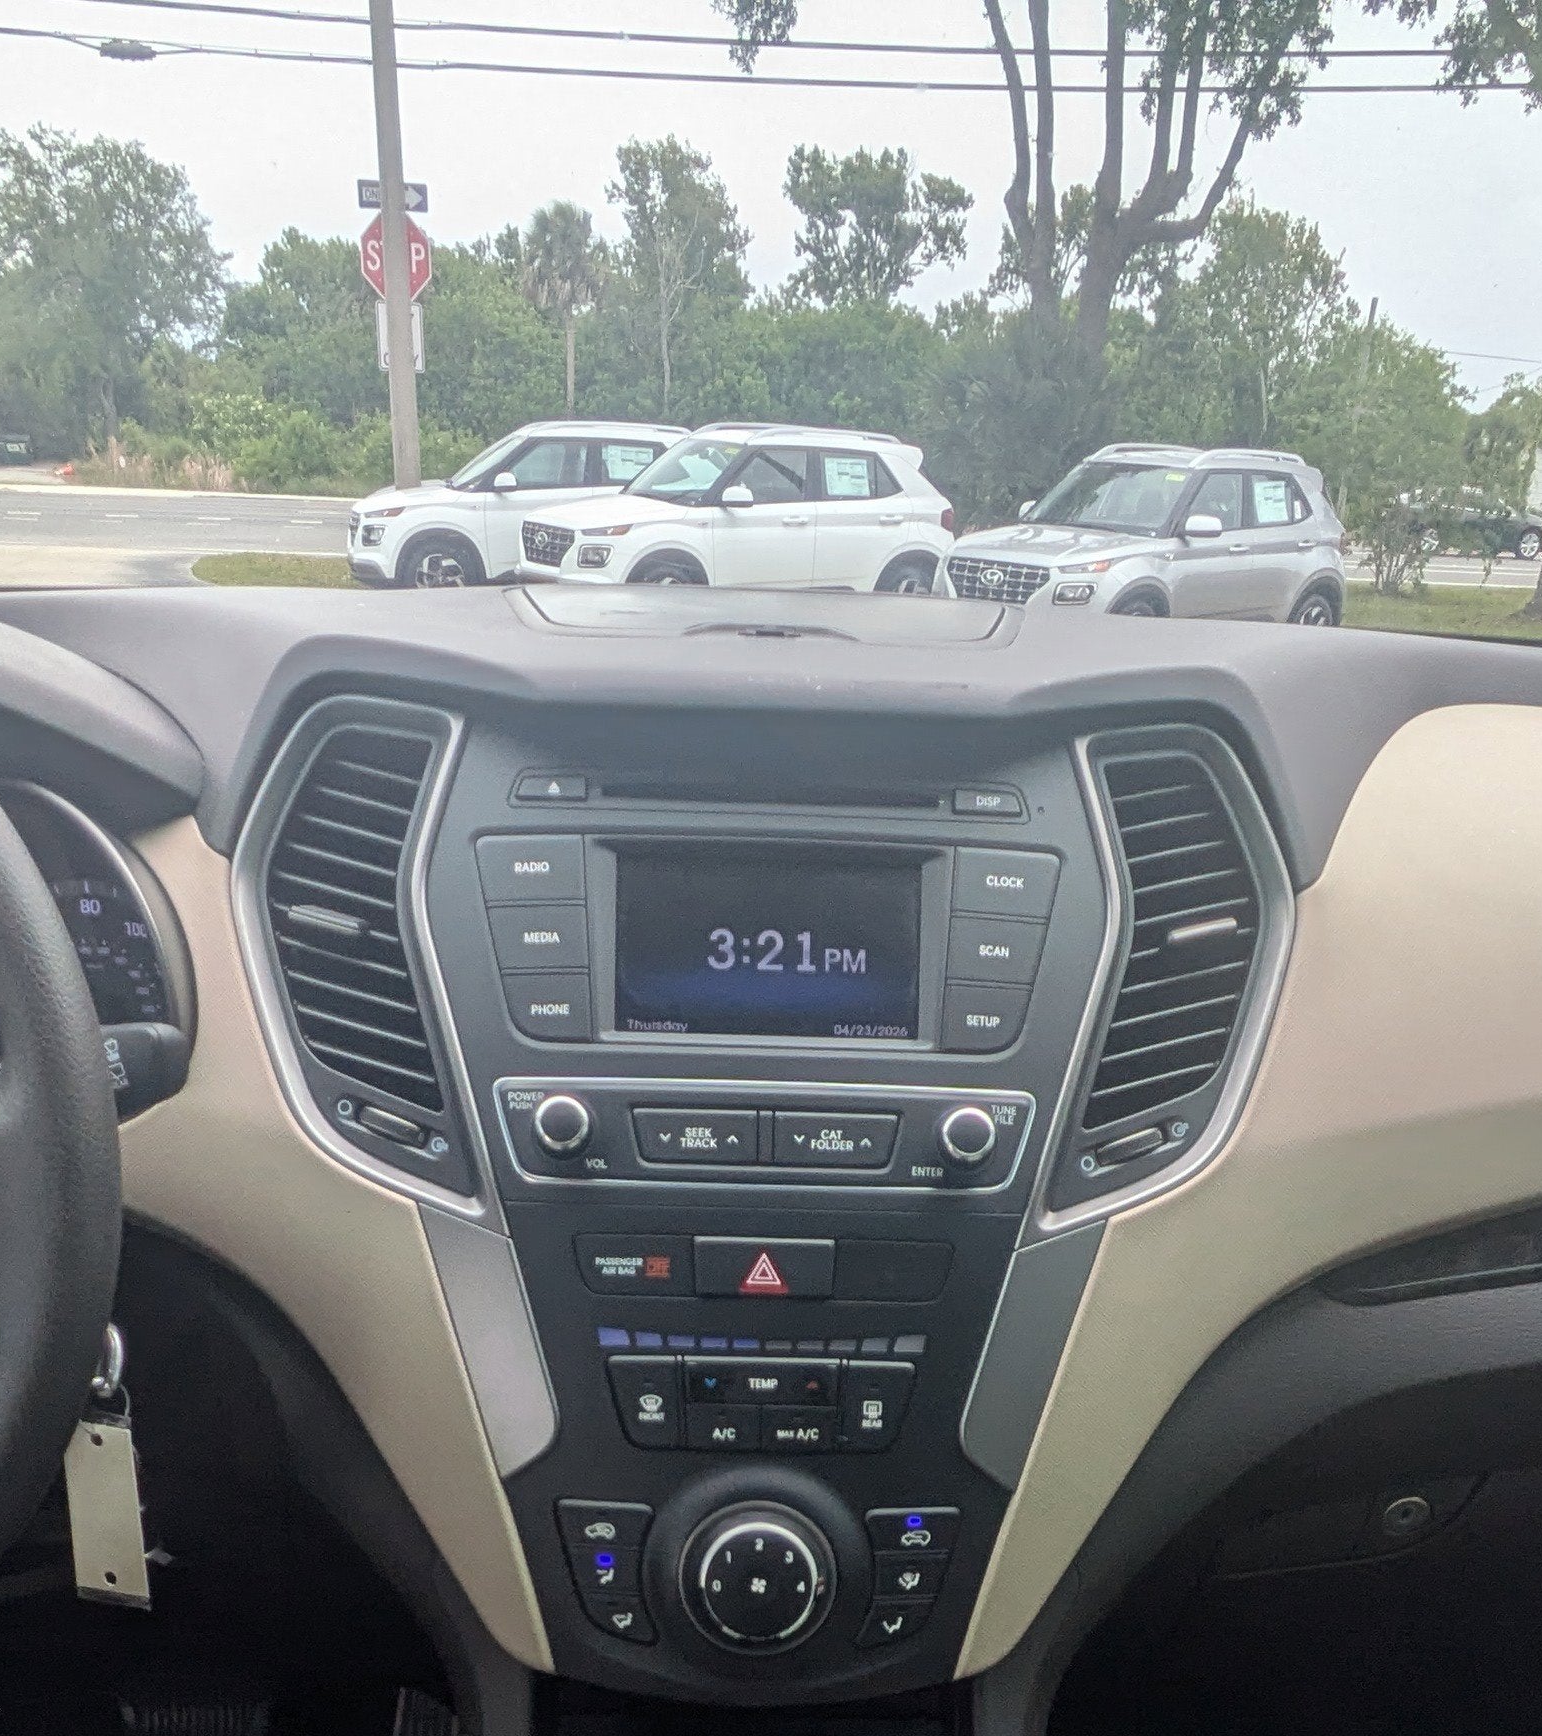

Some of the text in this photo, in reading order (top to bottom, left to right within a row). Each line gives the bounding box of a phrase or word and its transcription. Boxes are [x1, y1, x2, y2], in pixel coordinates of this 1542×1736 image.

[366, 239, 425, 274] SP
[514, 861, 550, 873] RADIO
[986, 875, 1025, 888] CLOCK
[80, 899, 101, 915] 80
[524, 931, 561, 945] MEDIA
[707, 928, 867, 974] 3:21 PM
[979, 945, 1010, 957] SCAN
[530, 1003, 570, 1016] PHONE
[627, 1018, 689, 1033] Thursday
[966, 1014, 1001, 1028] SETUP
[507, 1091, 544, 1102] POWER
[991, 1104, 1017, 1115] TUNE
[685, 1127, 712, 1138] SEEK
[821, 1130, 843, 1140] CAT
[680, 1137, 717, 1149] TRACK
[810, 1139, 854, 1151] FOLDER
[585, 1158, 608, 1170] VOL
[911, 1166, 944, 1178] ENTER
[595, 1256, 644, 1266] PASSENGER
[748, 1377, 779, 1390] TEMP
[712, 1427, 736, 1440] A/C
[796, 1427, 819, 1440] A/C
[785, 1550, 794, 1564] 3
[796, 1580, 806, 1593] 4
